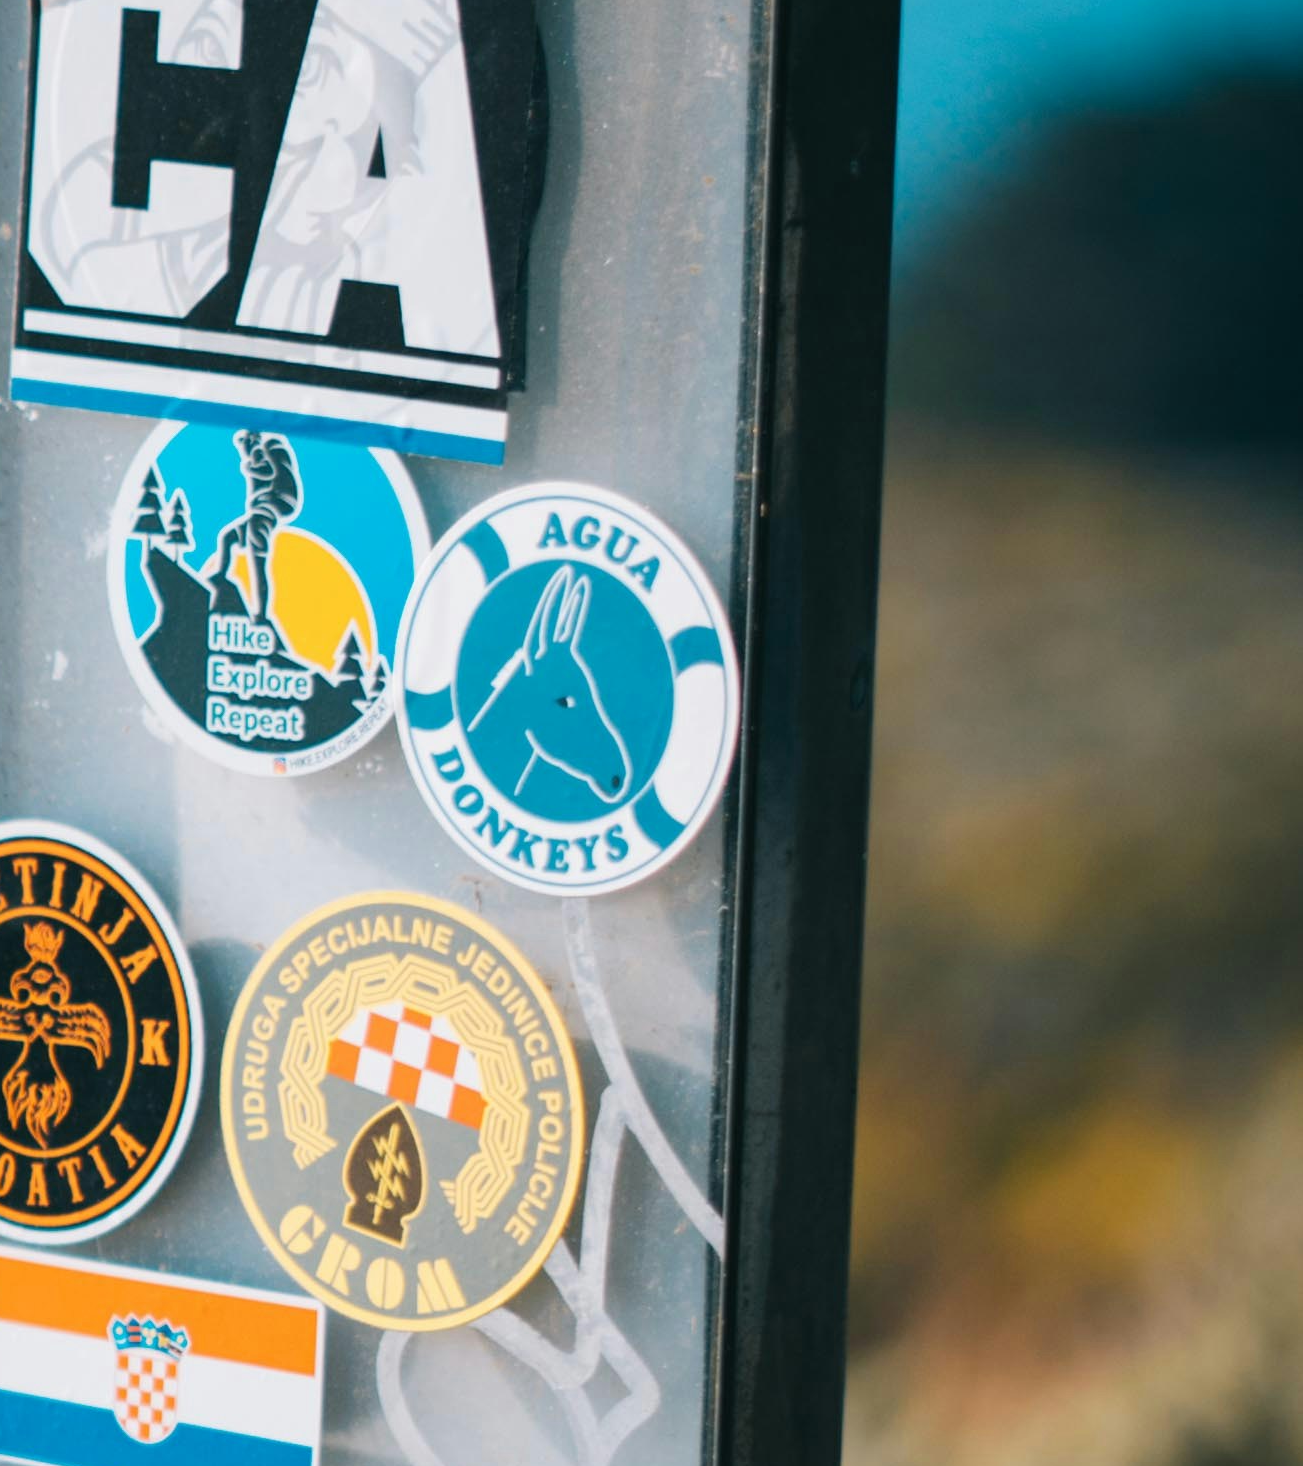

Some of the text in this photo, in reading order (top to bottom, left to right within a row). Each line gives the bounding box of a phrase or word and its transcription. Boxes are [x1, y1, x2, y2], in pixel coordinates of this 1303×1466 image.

[537, 512, 661, 593] AGUA
[211, 619, 272, 651] Hike
[211, 662, 310, 699] Explore
[210, 702, 301, 740] Repeat
[431, 745, 631, 875] DONKEYS
[140, 1018, 172, 1068] K
[241, 915, 565, 1247] UDRUGA SPECIJALNE JEDINICE POLICIJE
[278, 1204, 468, 1314] GROM
